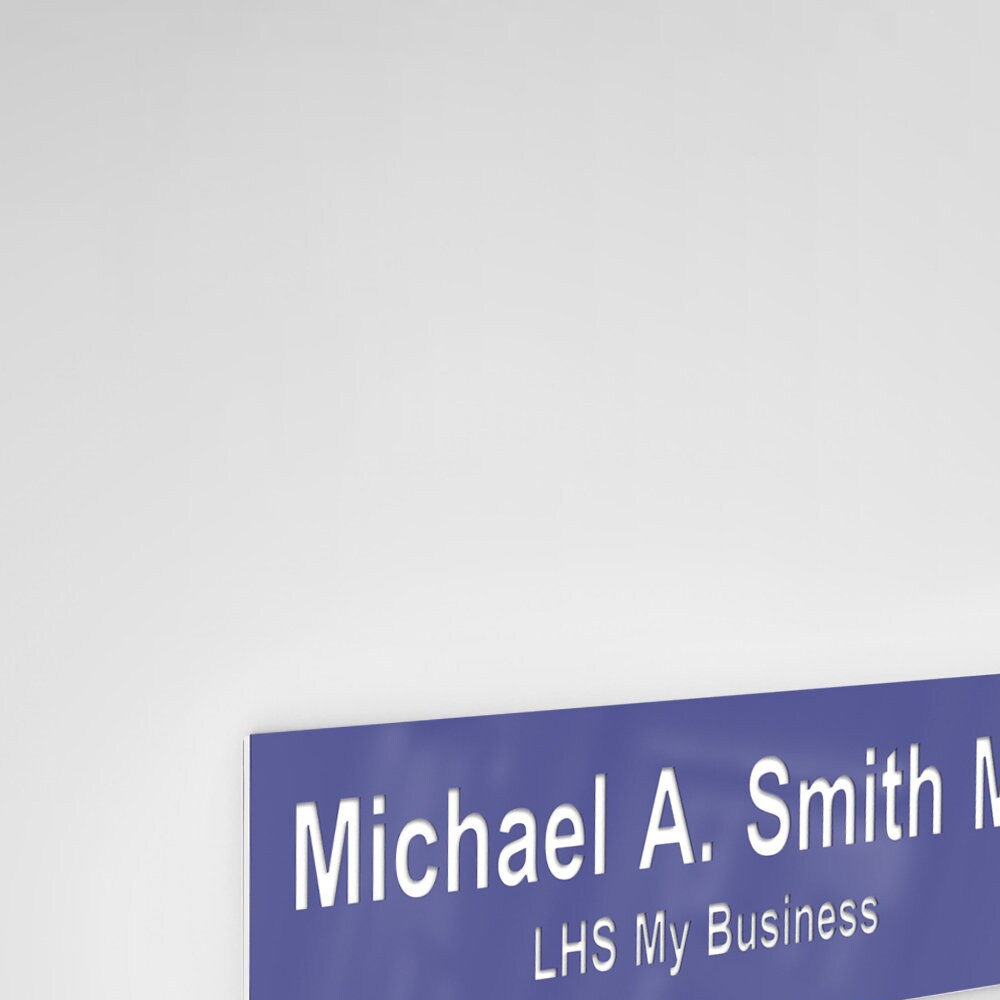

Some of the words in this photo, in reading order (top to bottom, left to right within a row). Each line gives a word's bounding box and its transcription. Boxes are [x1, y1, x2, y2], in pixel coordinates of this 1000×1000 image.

[294, 774, 607, 911] Michael
[639, 767, 713, 870] A.
[746, 743, 943, 857] Smith
[533, 917, 617, 982] LHS
[635, 910, 691, 977] My
[707, 895, 880, 956] Business
